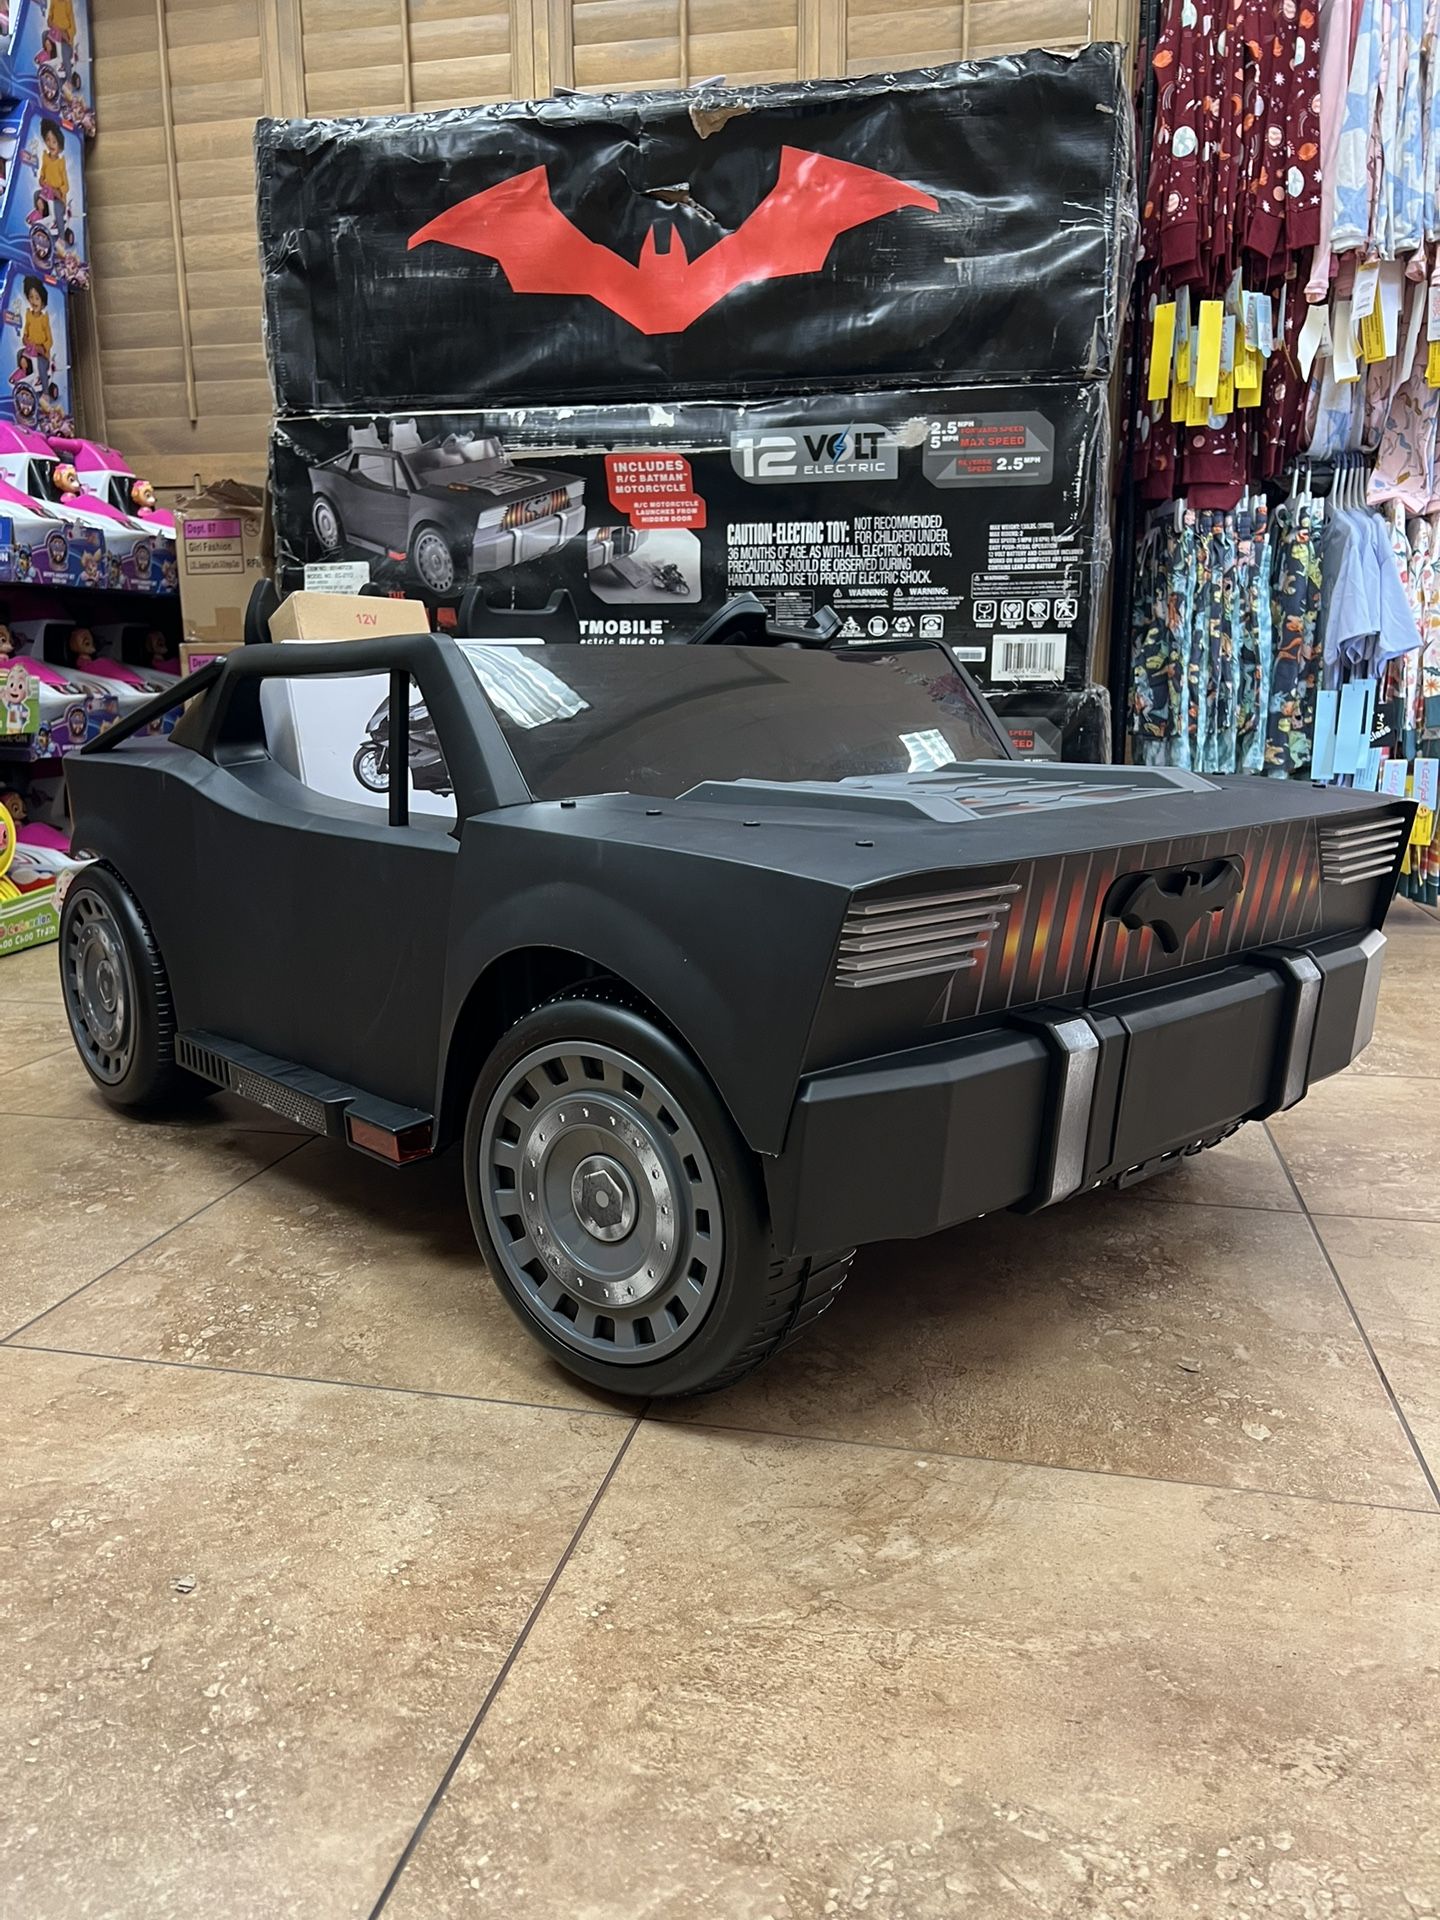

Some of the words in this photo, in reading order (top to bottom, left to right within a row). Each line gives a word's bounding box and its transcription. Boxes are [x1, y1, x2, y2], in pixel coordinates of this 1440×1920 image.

[931, 422, 957, 435] 2.5
[930, 436, 941, 449] 5
[960, 438, 985, 446] MAX
[988, 436, 1024, 446] SPEED
[736, 436, 798, 477] 12
[803, 431, 886, 462] VOLT
[613, 460, 684, 472] INCLUDES
[804, 462, 886, 475] ELECTRIC
[996, 457, 1024, 470] 2.5
[616, 475, 637, 483] R/C
[615, 484, 686, 493] MOTORCYCLE
[650, 500, 699, 508] MOTORCYCLE
[636, 508, 675, 516] LAUNCHES
[854, 516, 872, 530] NOT
[874, 515, 942, 530] RECOMMENDED
[727, 521, 824, 546] CAUTION-ELECTRIC
[826, 520, 850, 544] TOY:
[854, 530, 872, 544] FOR
[873, 530, 916, 543] CHILDREN
[917, 528, 948, 542] UNDER
[728, 547, 739, 560] 36
[740, 546, 776, 560] MONTHS
[777, 546, 789, 559] OF
[809, 545, 821, 558] AS
[822, 545, 844, 558] WITH
[845, 544, 861, 558] ALL
[862, 544, 902, 557] ELECTRIC
[904, 542, 953, 558] PRODUCTS,
[728, 560, 784, 573] PRECAUTIONS
[785, 559, 819, 572] SHOULD
[820, 559, 832, 572] BE
[833, 558, 877, 571] OBSERVED
[879, 557, 912, 570] DURING
[728, 573, 770, 586] HANDLING
[771, 573, 788, 586] AND
[789, 573, 806, 586] USE
[807, 573, 818, 586] TO
[820, 572, 857, 585] PREVENT
[859, 571, 899, 584] ELECTRIC
[909, 588, 948, 596] WARNING:
[356, 614, 377, 625] 12V
